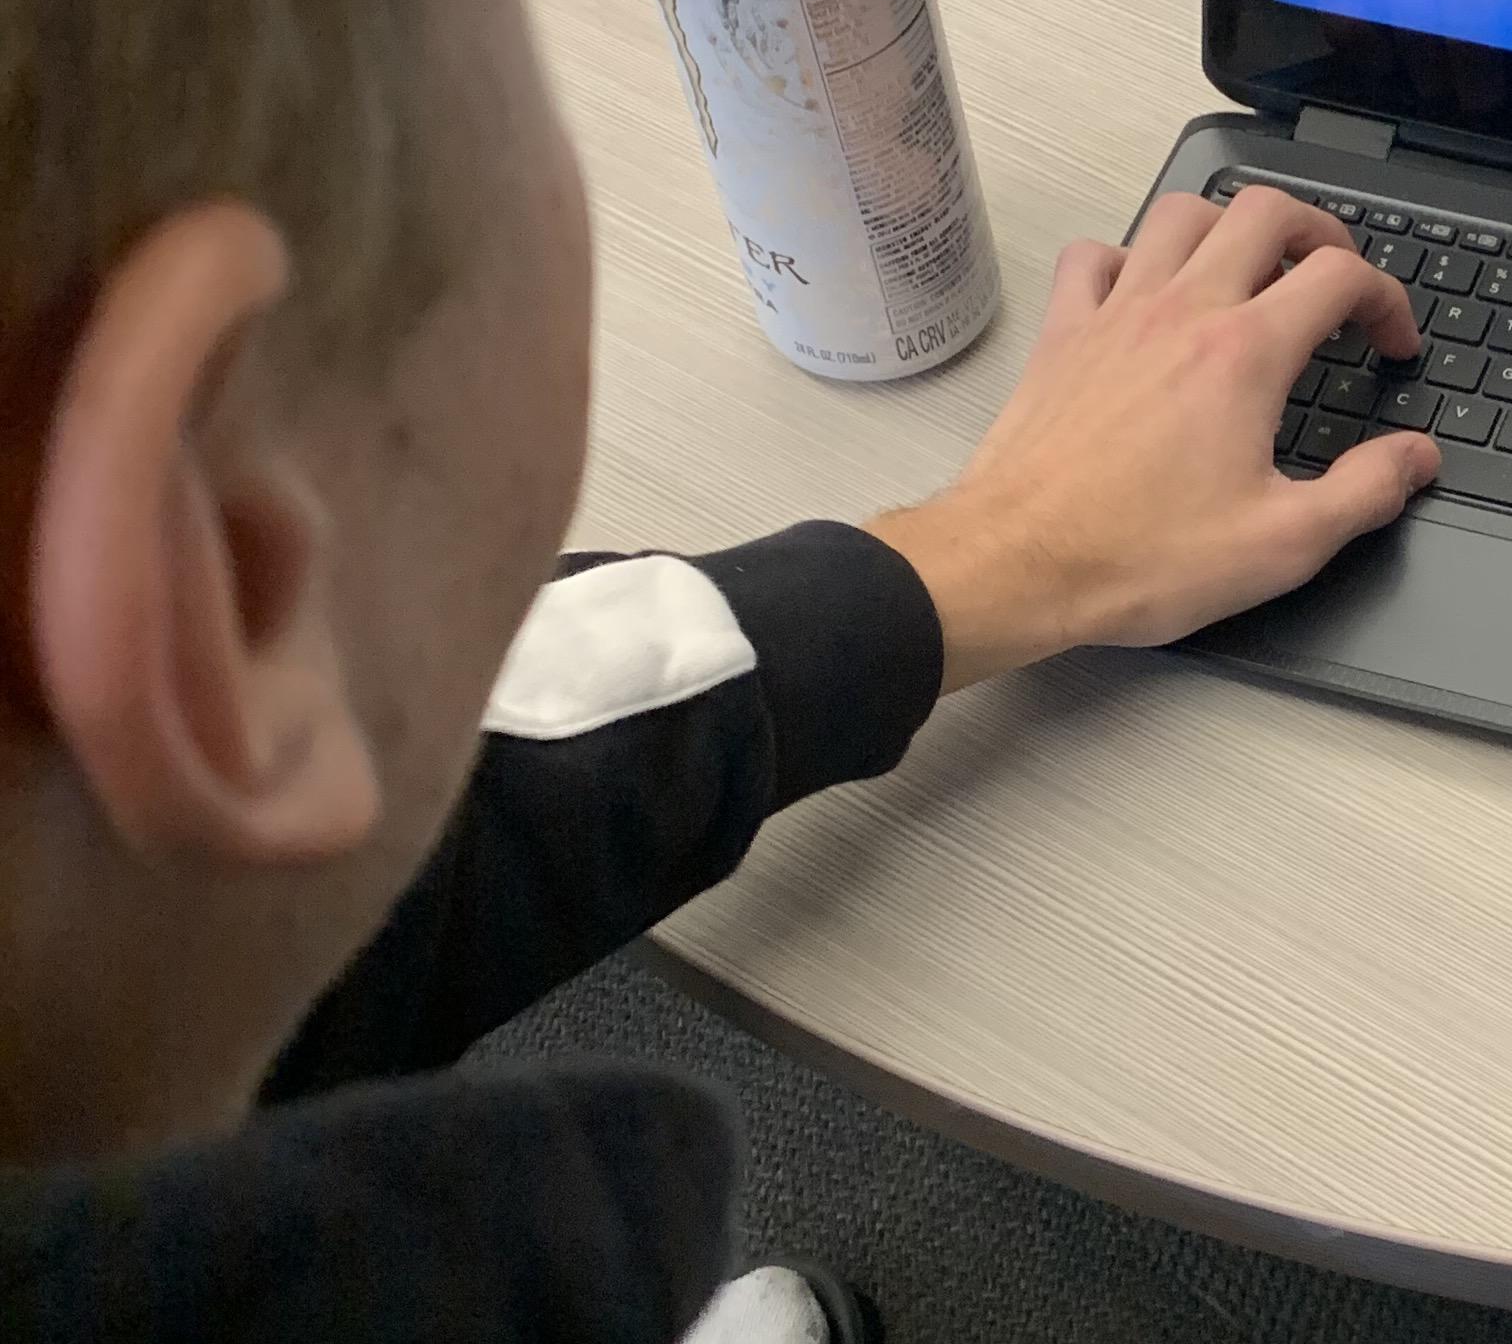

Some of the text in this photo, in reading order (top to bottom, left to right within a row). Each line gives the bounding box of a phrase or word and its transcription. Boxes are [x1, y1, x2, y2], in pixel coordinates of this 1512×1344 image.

[727, 219, 811, 286] TER
[1376, 258, 1389, 269] 3
[1433, 271, 1444, 281] 4
[1489, 282, 1501, 294] 5
[1448, 306, 1462, 319] R
[895, 319, 946, 361] CA CRV
[1442, 354, 1457, 365] F
[1338, 380, 1352, 392] X
[1396, 393, 1410, 405] C
[1456, 406, 1469, 418] V
